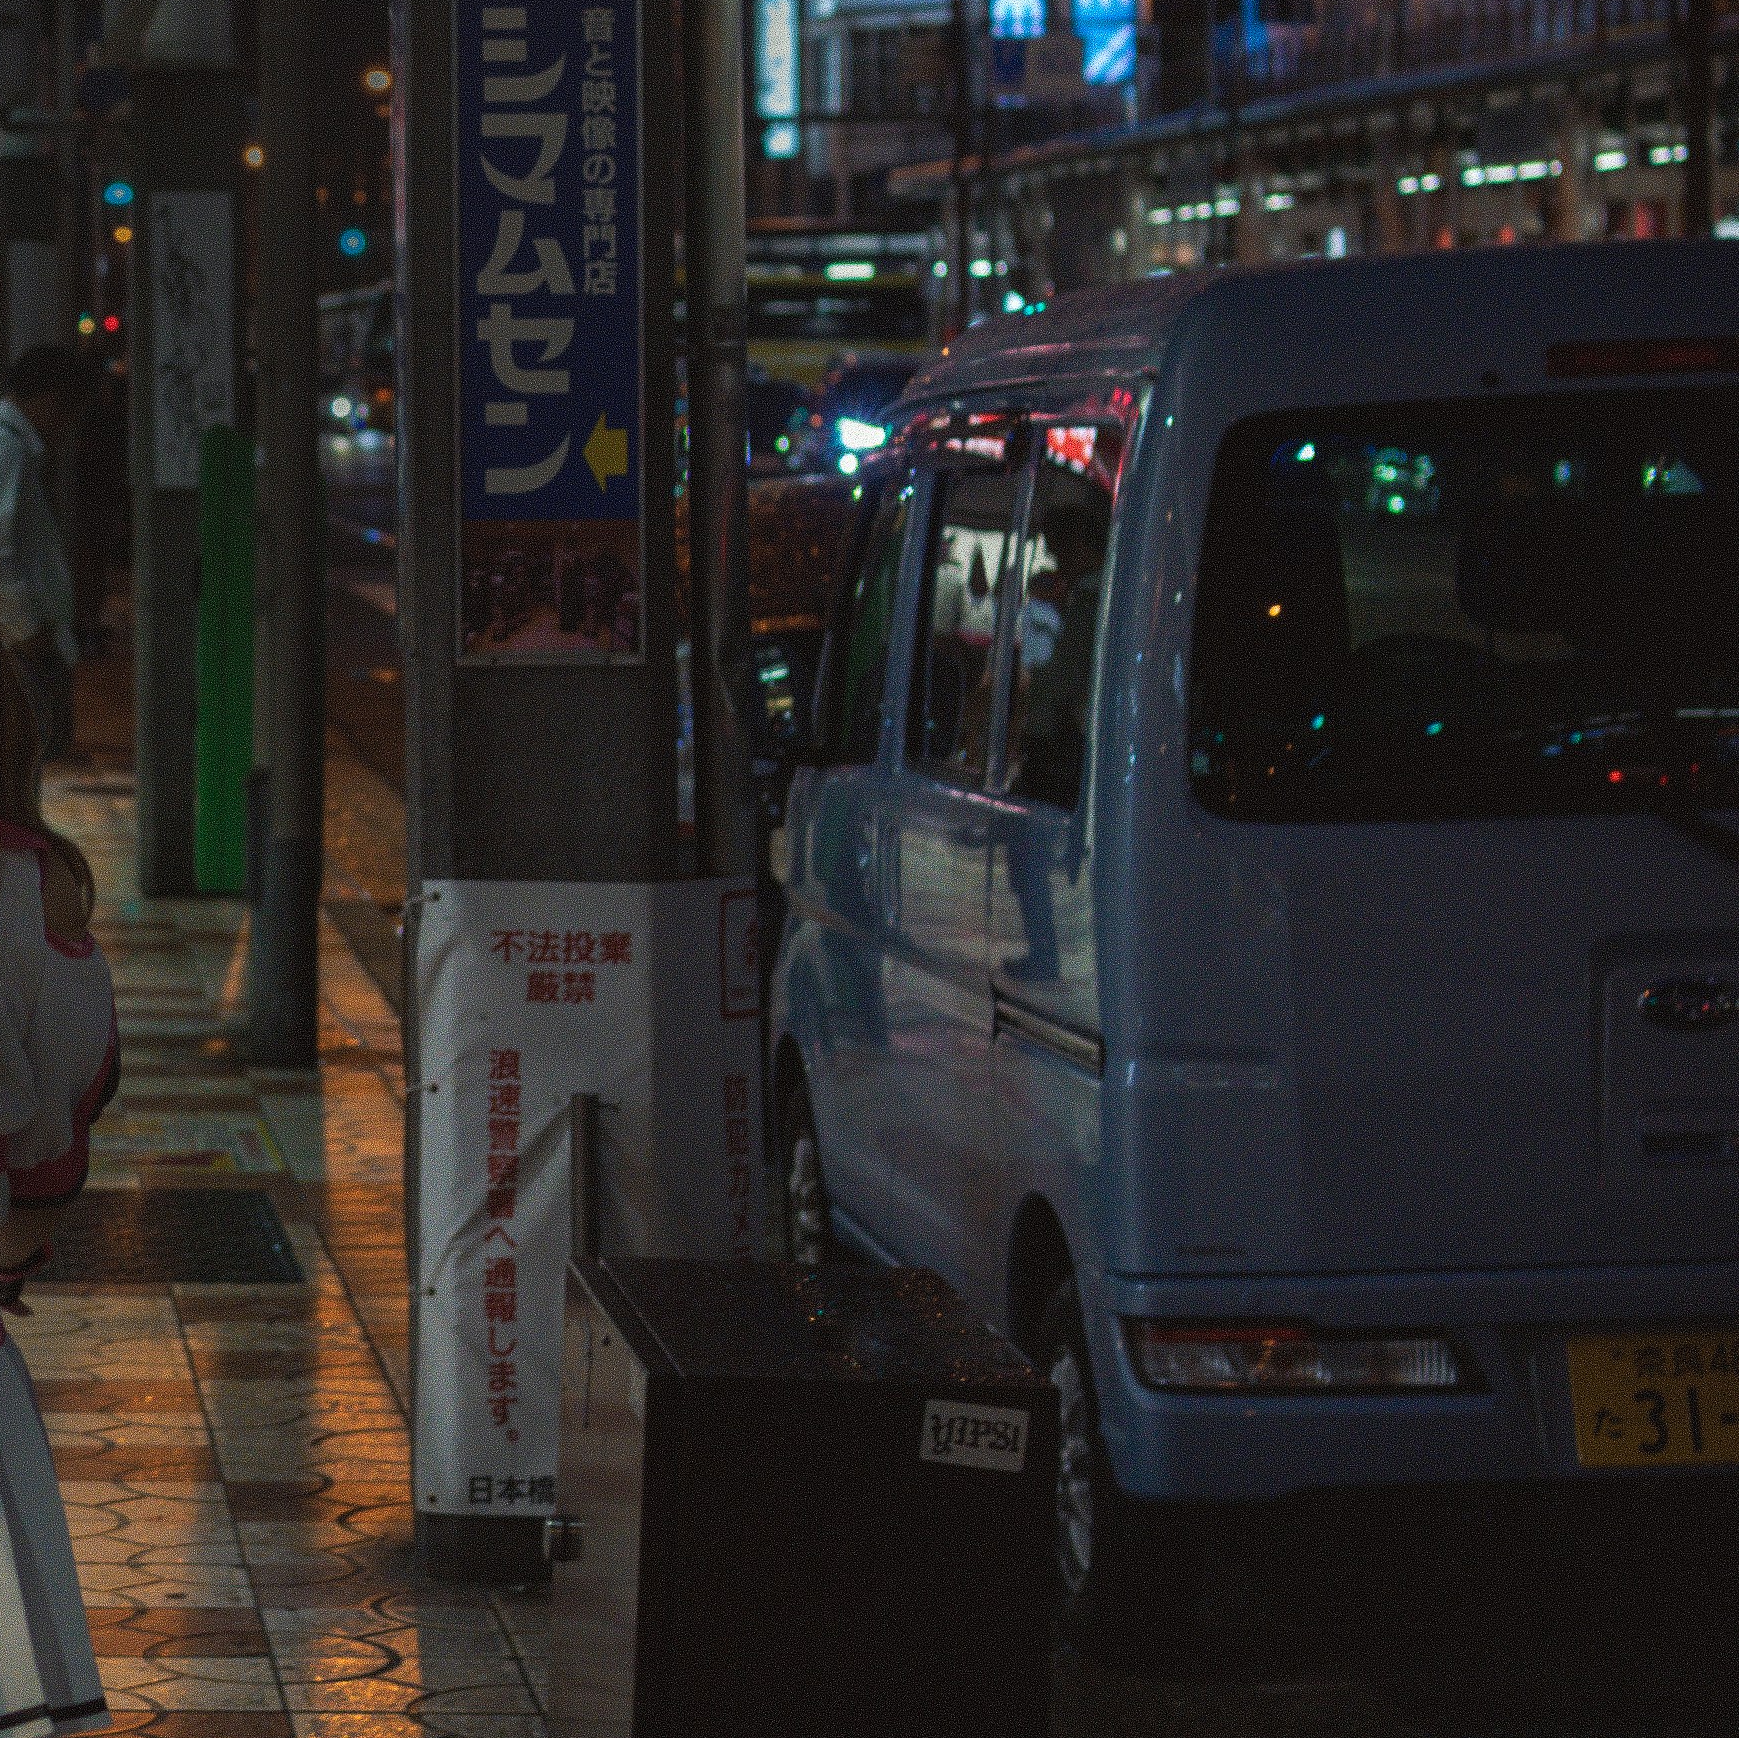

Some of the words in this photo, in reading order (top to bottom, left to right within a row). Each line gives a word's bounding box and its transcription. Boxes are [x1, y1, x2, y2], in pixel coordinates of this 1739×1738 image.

[580, 5, 618, 296] 音と映像の専門店
[475, 5, 576, 496] シマムセン
[490, 929, 633, 965] 不法投棄
[525, 970, 597, 1005] 厳禁
[468, 1475, 556, 1504] 日本橋
